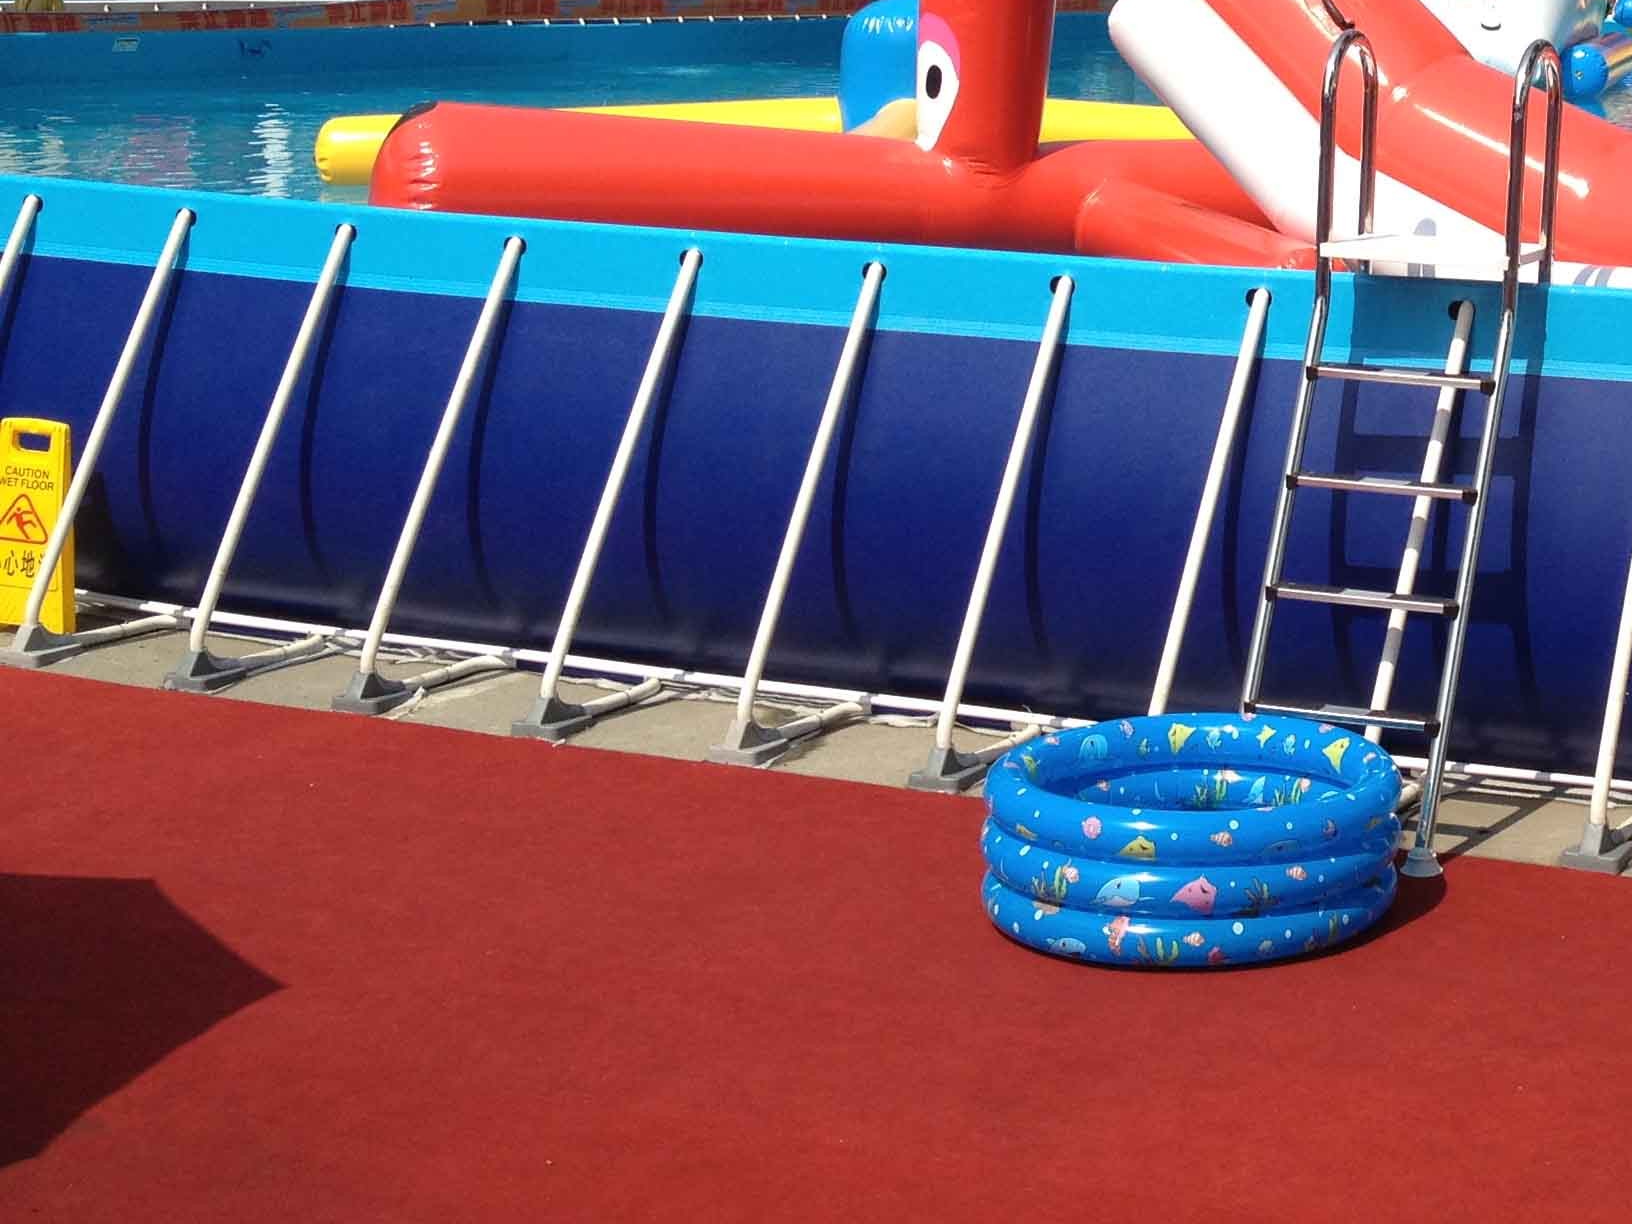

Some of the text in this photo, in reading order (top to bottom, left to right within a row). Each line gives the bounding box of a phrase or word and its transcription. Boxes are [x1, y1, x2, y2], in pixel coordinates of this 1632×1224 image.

[5, 465, 50, 480] CAUTION
[21, 479, 55, 491] FLOOR
[0, 549, 46, 578] 心地
